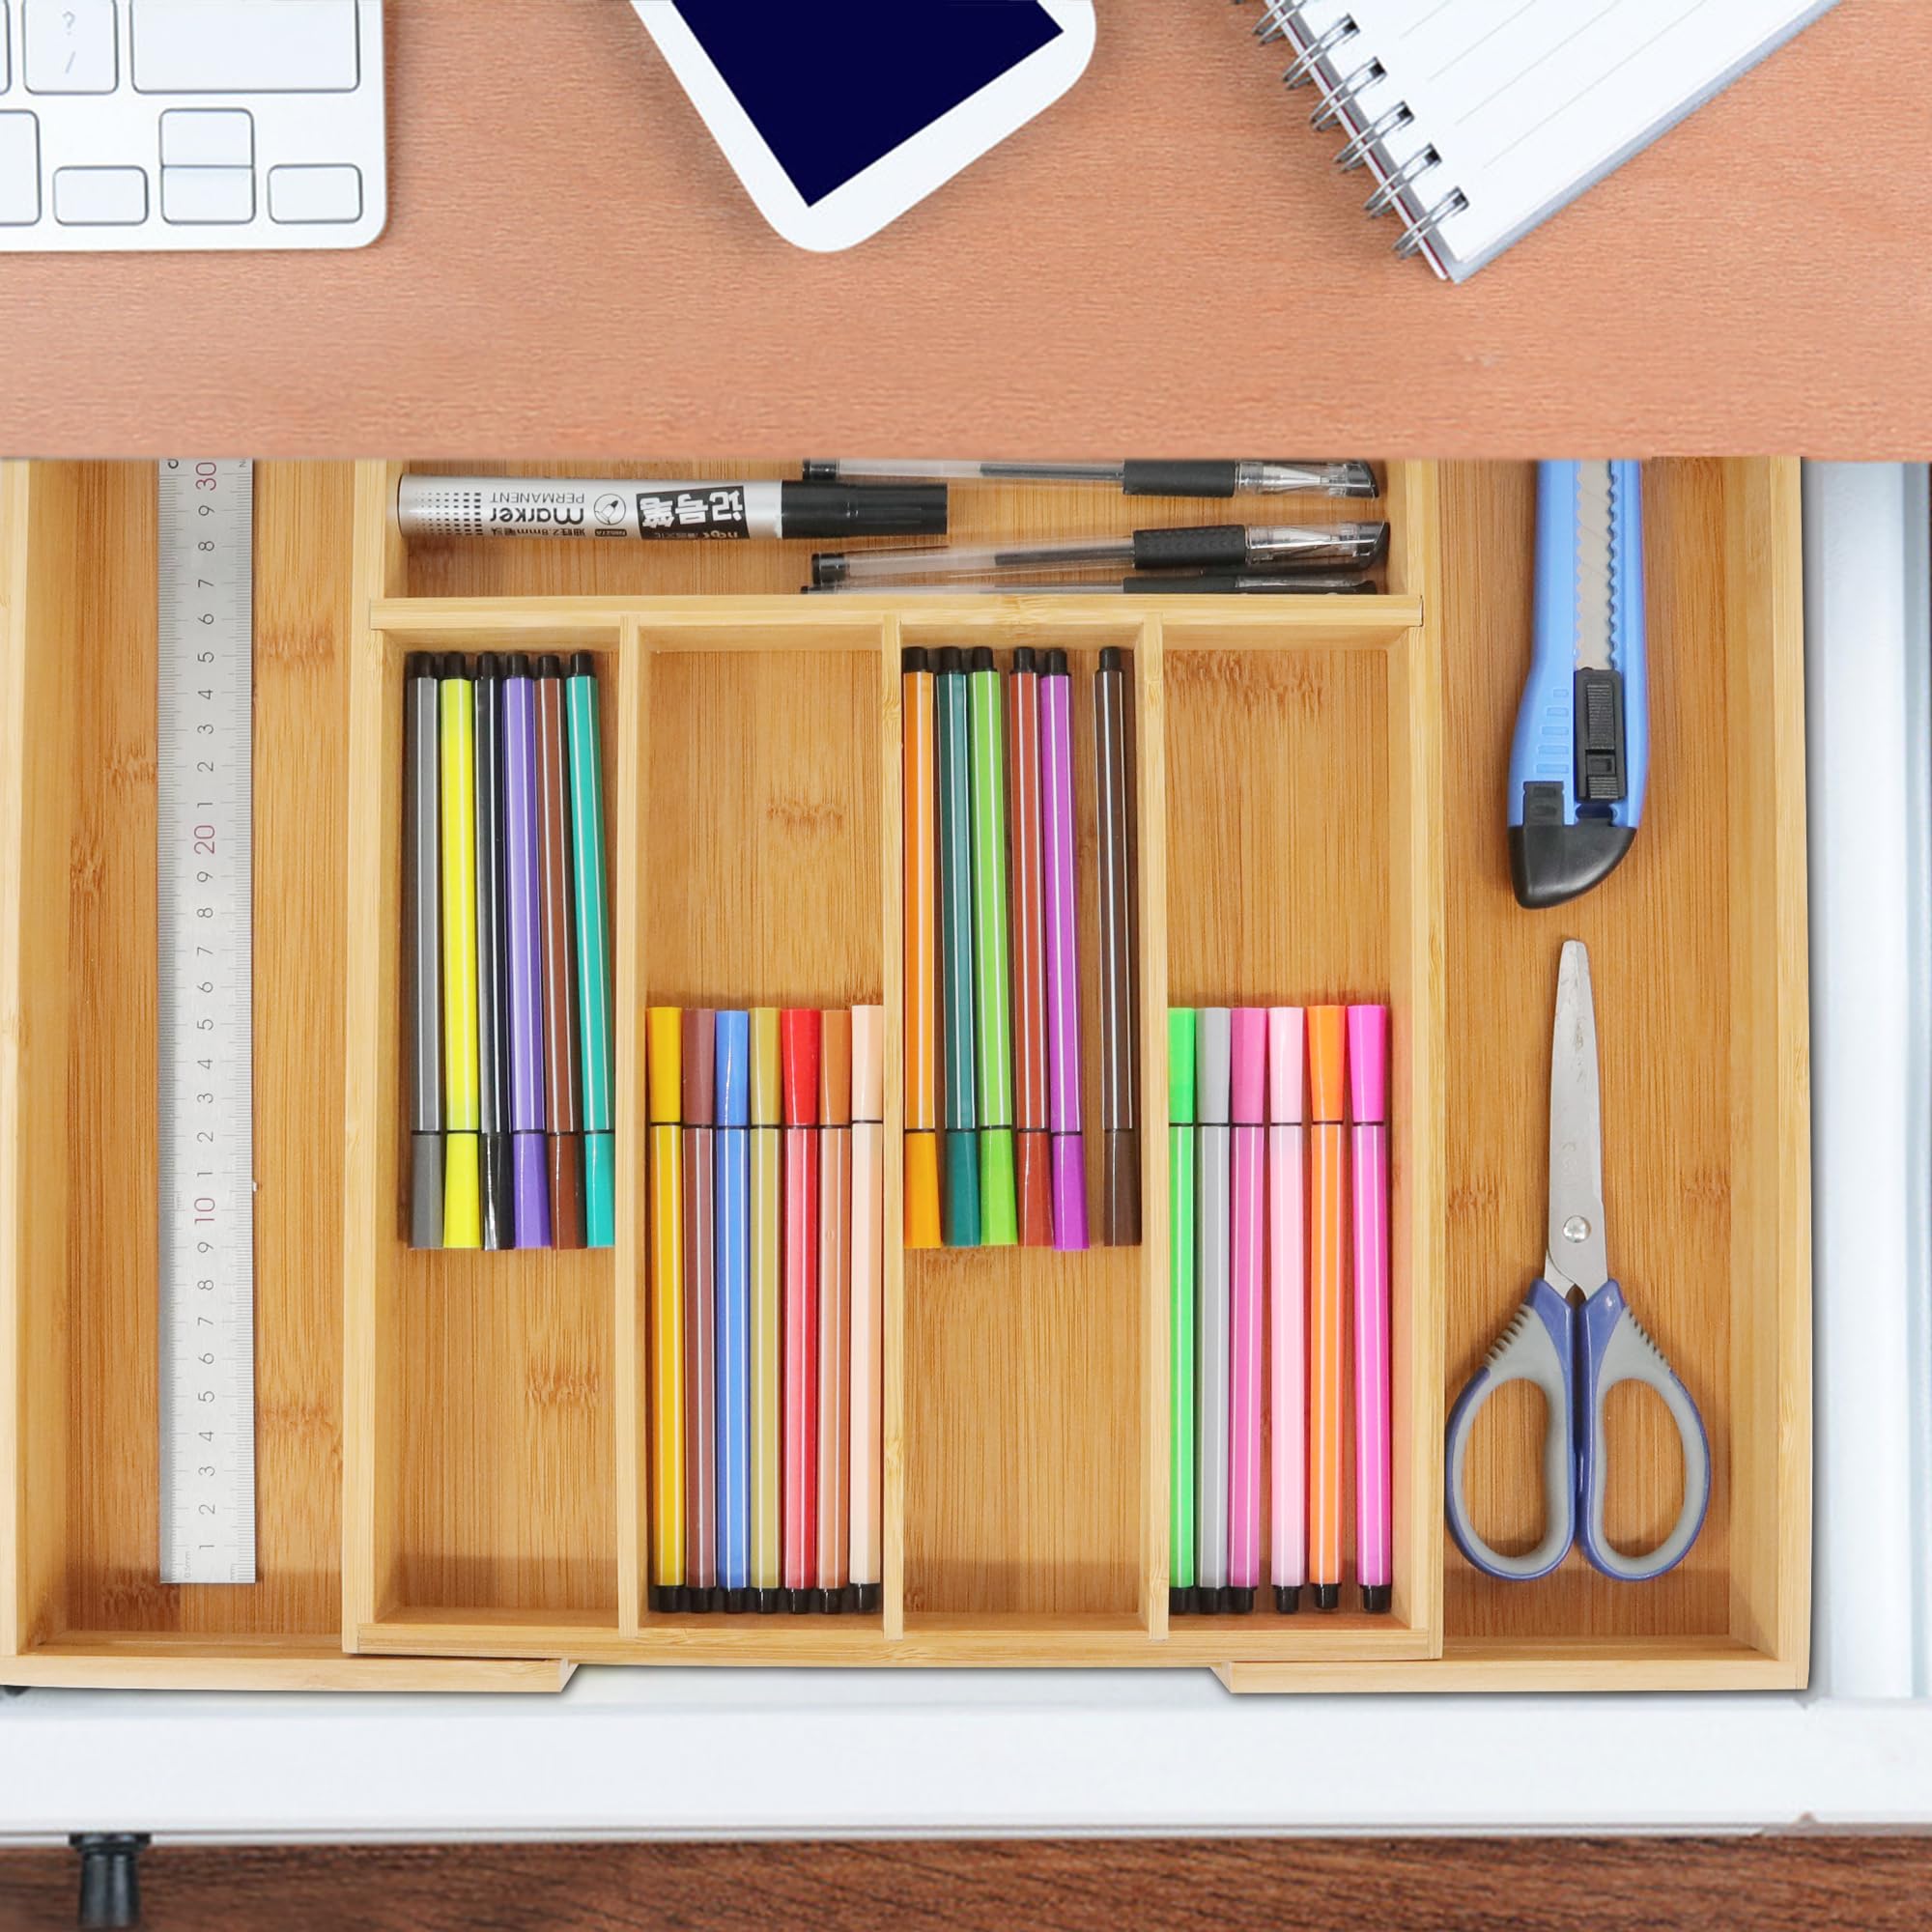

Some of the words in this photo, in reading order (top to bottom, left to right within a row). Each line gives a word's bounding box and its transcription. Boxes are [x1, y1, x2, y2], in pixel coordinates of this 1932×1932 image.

[62, 11, 76, 36] ?
[194, 461, 218, 493] 30
[490, 492, 584, 504] PERMANENT
[197, 504, 215, 517] 9
[639, 490, 744, 528] 记号笔
[490, 507, 584, 525] marker
[197, 540, 215, 552] 8
[197, 579, 214, 588] 7
[197, 613, 214, 626] 6
[197, 651, 215, 664] 5
[197, 689, 213, 700] 4
[196, 724, 214, 735] 3
[196, 761, 214, 773] 2
[193, 825, 215, 855] 20
[196, 870, 213, 883] 9
[196, 907, 213, 919] 8
[196, 946, 213, 955] 7
[196, 981, 213, 994] 6
[196, 1018, 214, 1031] 5
[196, 1058, 213, 1070] 4
[196, 1093, 214, 1104] 3
[196, 1131, 214, 1143] 2
[193, 1197, 215, 1225] 10
[196, 1241, 214, 1254] 9
[196, 1279, 214, 1292] 8
[197, 1317, 213, 1326] 7
[197, 1352, 214, 1365] 6
[197, 1390, 215, 1403] 5
[198, 1431, 214, 1442] 4
[197, 1465, 215, 1477] 3
[198, 1504, 216, 1516] 2
